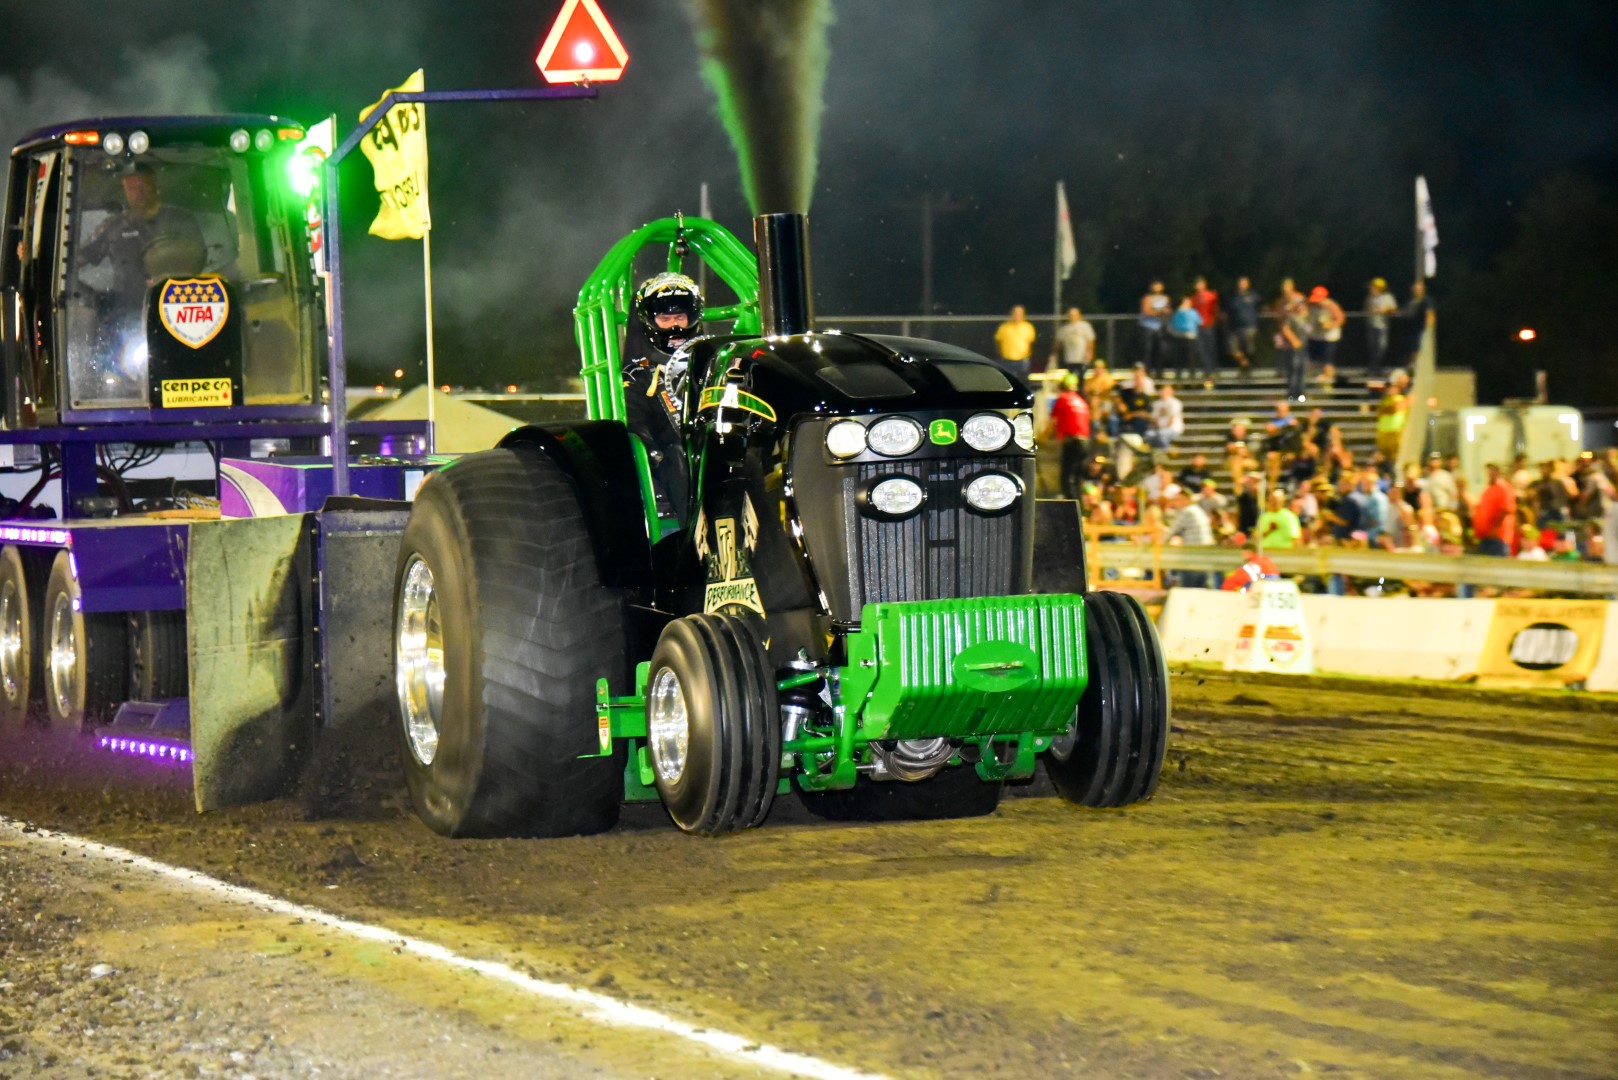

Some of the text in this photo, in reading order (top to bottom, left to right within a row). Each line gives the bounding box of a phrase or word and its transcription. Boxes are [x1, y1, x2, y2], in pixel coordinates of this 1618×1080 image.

[176, 306, 213, 323] NTPA
[167, 395, 219, 403] LUBRICANTS
[707, 582, 756, 607] PERFORMANCE
